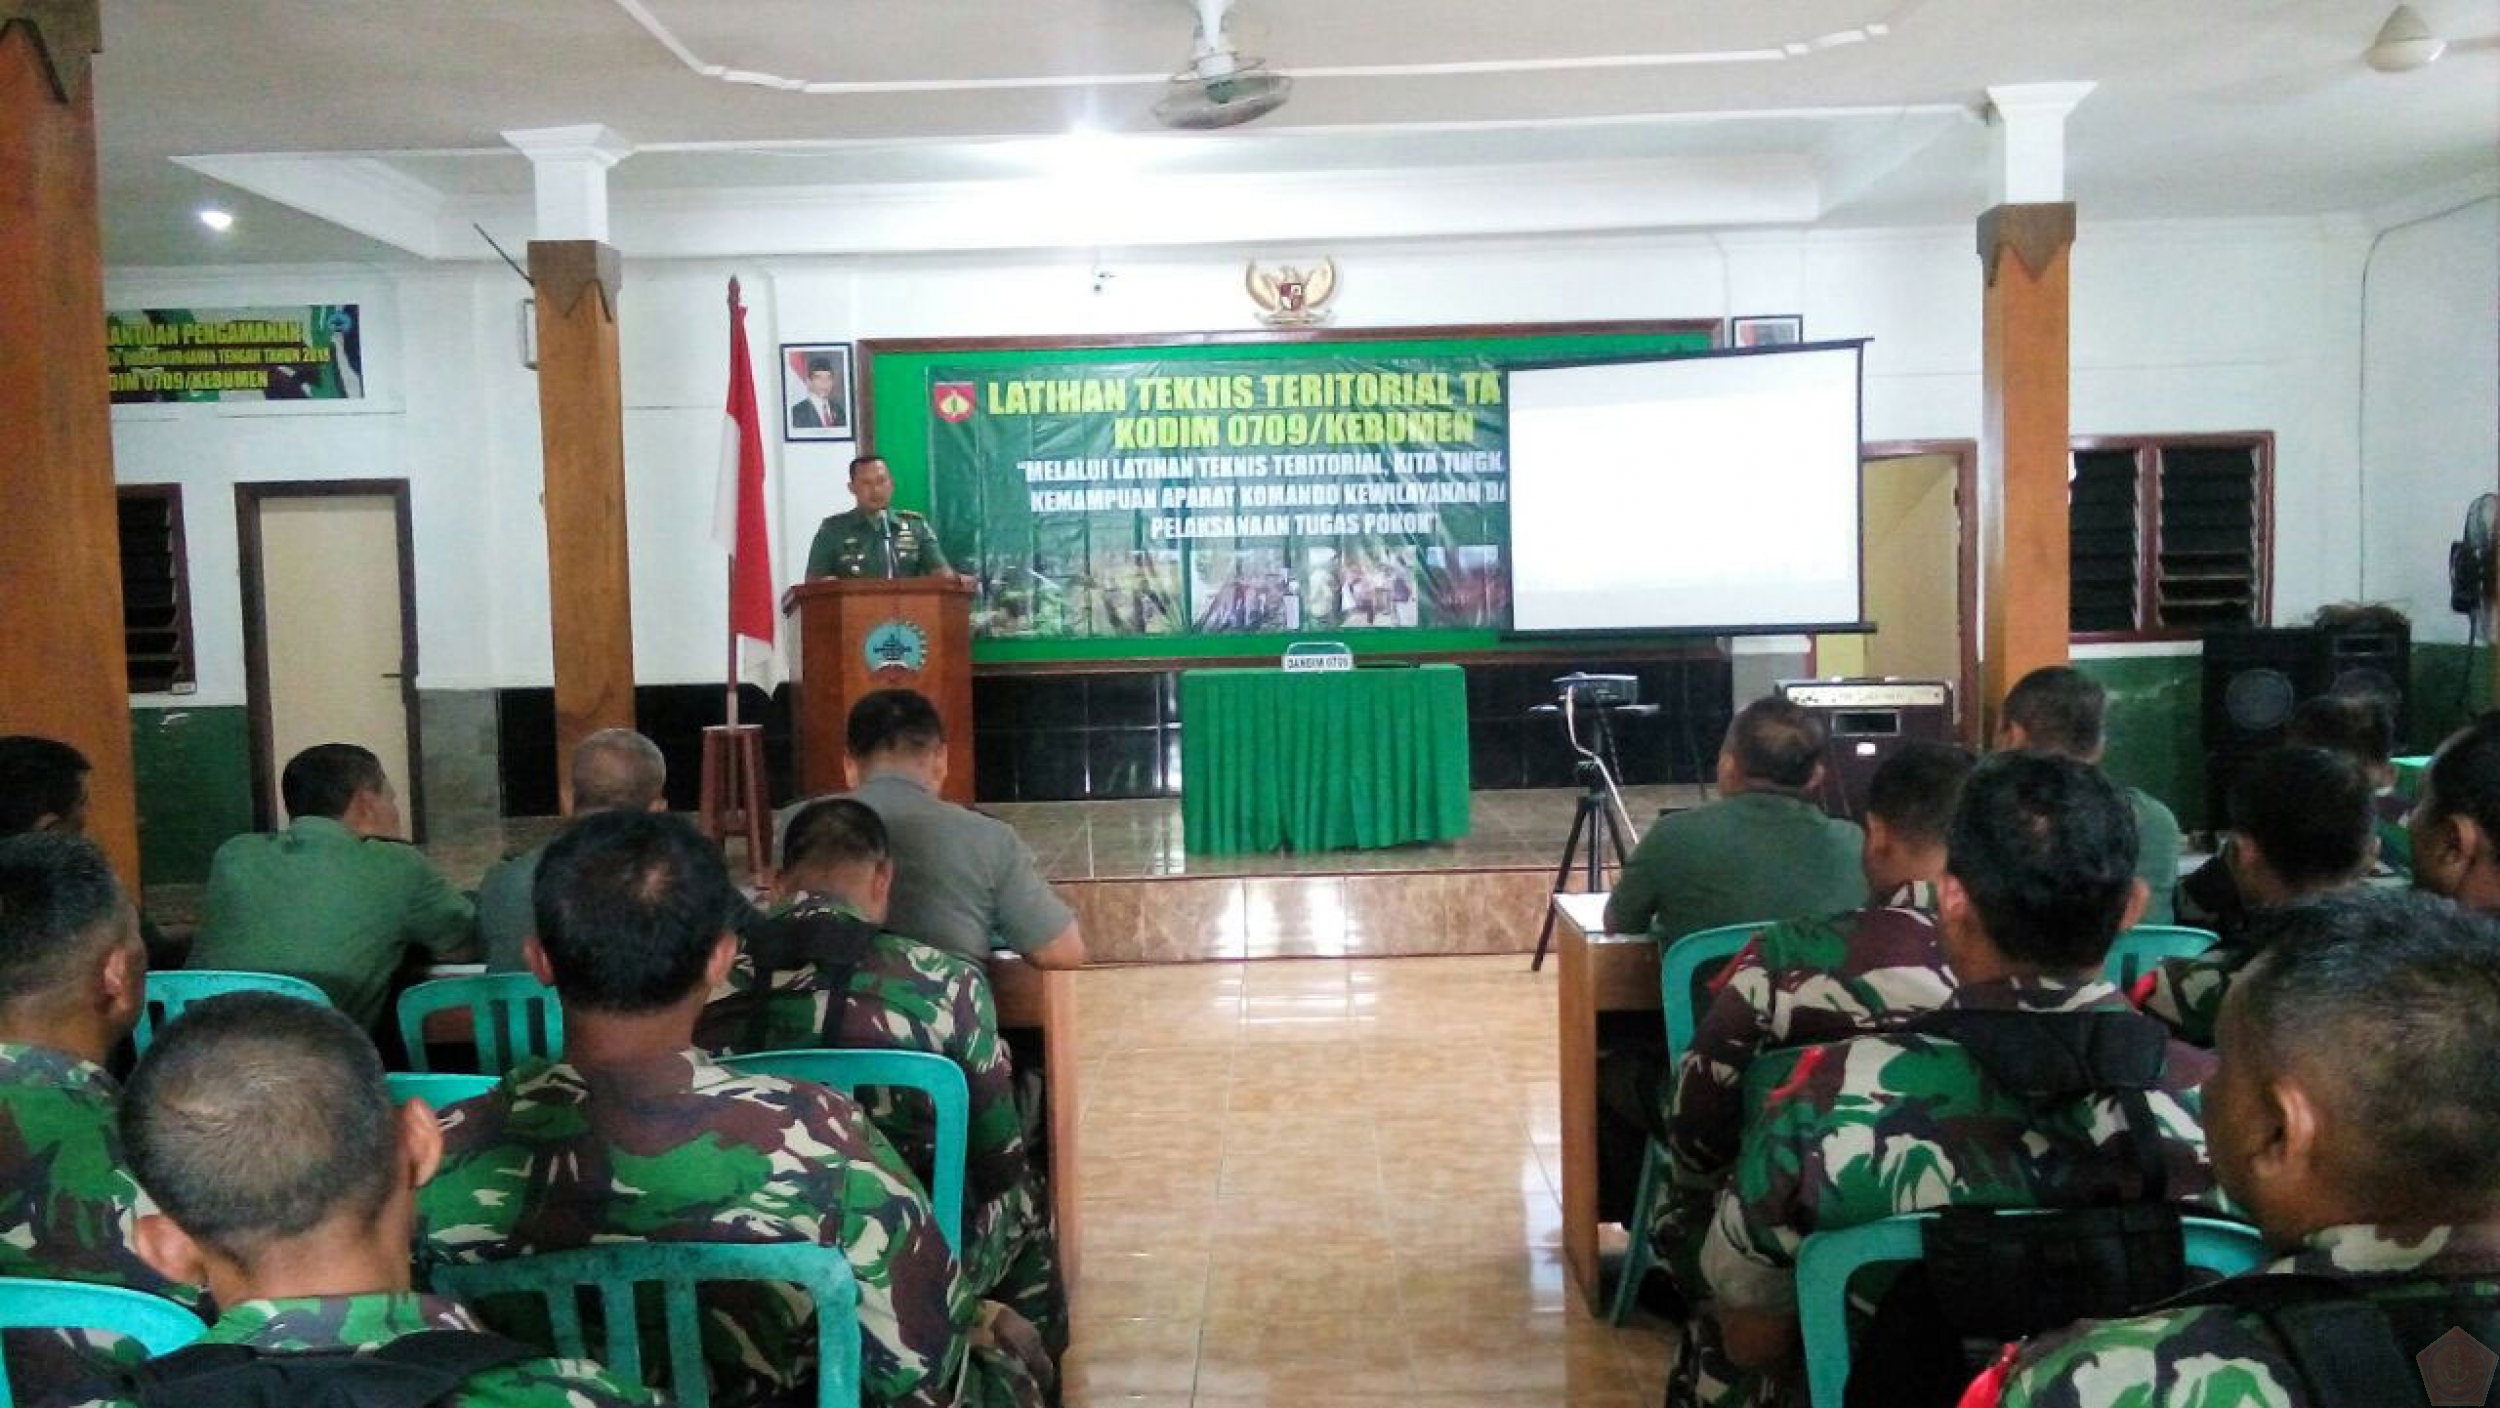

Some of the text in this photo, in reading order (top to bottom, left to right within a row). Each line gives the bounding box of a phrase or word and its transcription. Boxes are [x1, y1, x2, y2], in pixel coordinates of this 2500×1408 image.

[109, 323, 179, 346] ANTUAN
[109, 372, 140, 392] DIM
[988, 370, 1501, 414] LATIHAN TEKNIS TERITORIAL TA
[1115, 411, 1475, 449] KODIM 0709/KEBUMEN
[1112, 456, 1194, 479] LATIHAN
[1197, 454, 1268, 478] TEKNIS
[1272, 452, 1390, 476] TERITORIAL,
[1394, 452, 1438, 473] KITA
[1441, 450, 1503, 473] TINGK
[1031, 487, 1157, 512] KEMAMPUAN
[1161, 485, 1237, 509] APARAT
[1239, 483, 1342, 507] KOMANDO
[1151, 514, 1290, 540] PELAKSANAAN
[1294, 512, 1361, 537] TUGAS
